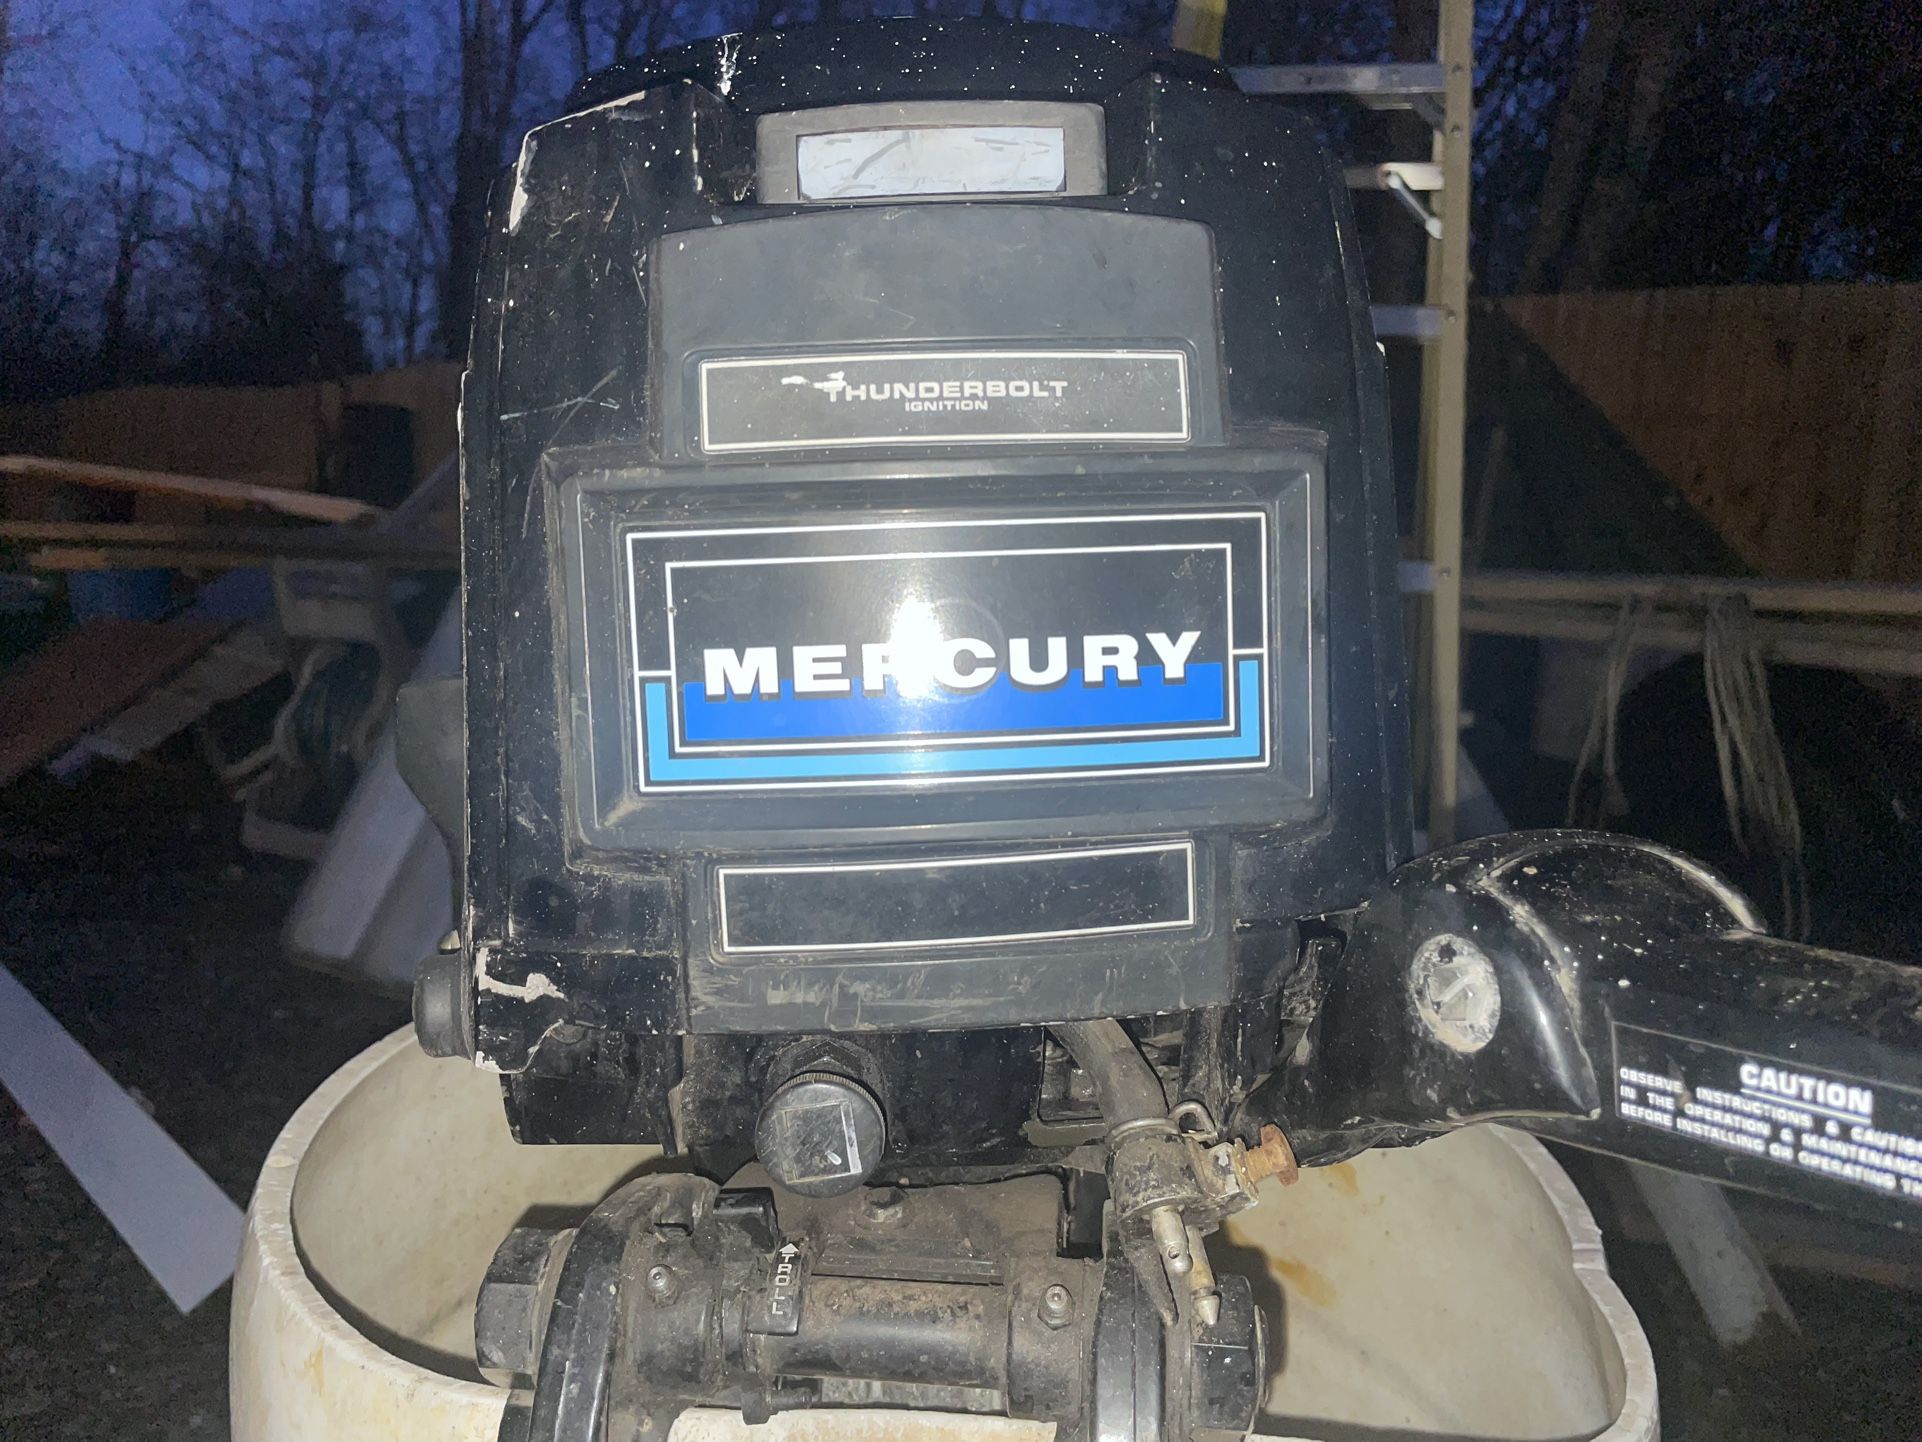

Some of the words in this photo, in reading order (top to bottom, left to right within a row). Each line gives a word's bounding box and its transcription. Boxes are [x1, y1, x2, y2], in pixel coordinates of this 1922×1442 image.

[813, 374, 1068, 402] THUNDERBOLT
[904, 400, 988, 412] IGNITION
[703, 631, 1201, 695] MERCURY
[1619, 1066, 1683, 1093] OBSERVE
[1696, 1086, 1813, 1129] INSTRUCTIONS
[1825, 1119, 1840, 1137] &
[1740, 1063, 1872, 1114] CAUTION
[1619, 1084, 1637, 1100] IN
[1646, 1091, 1675, 1110] THE
[1684, 1102, 1772, 1138] OPERATION
[1780, 1127, 1795, 1143] &
[1801, 1132, 1922, 1177] MAINTENANC
[1620, 1101, 1673, 1127] BEFORE
[1676, 1116, 1766, 1152] INSTALLING
[1769, 1141, 1795, 1162] OR
[1798, 1150, 1896, 1190] OPERATING
[771, 1254, 795, 1315] TROLL
